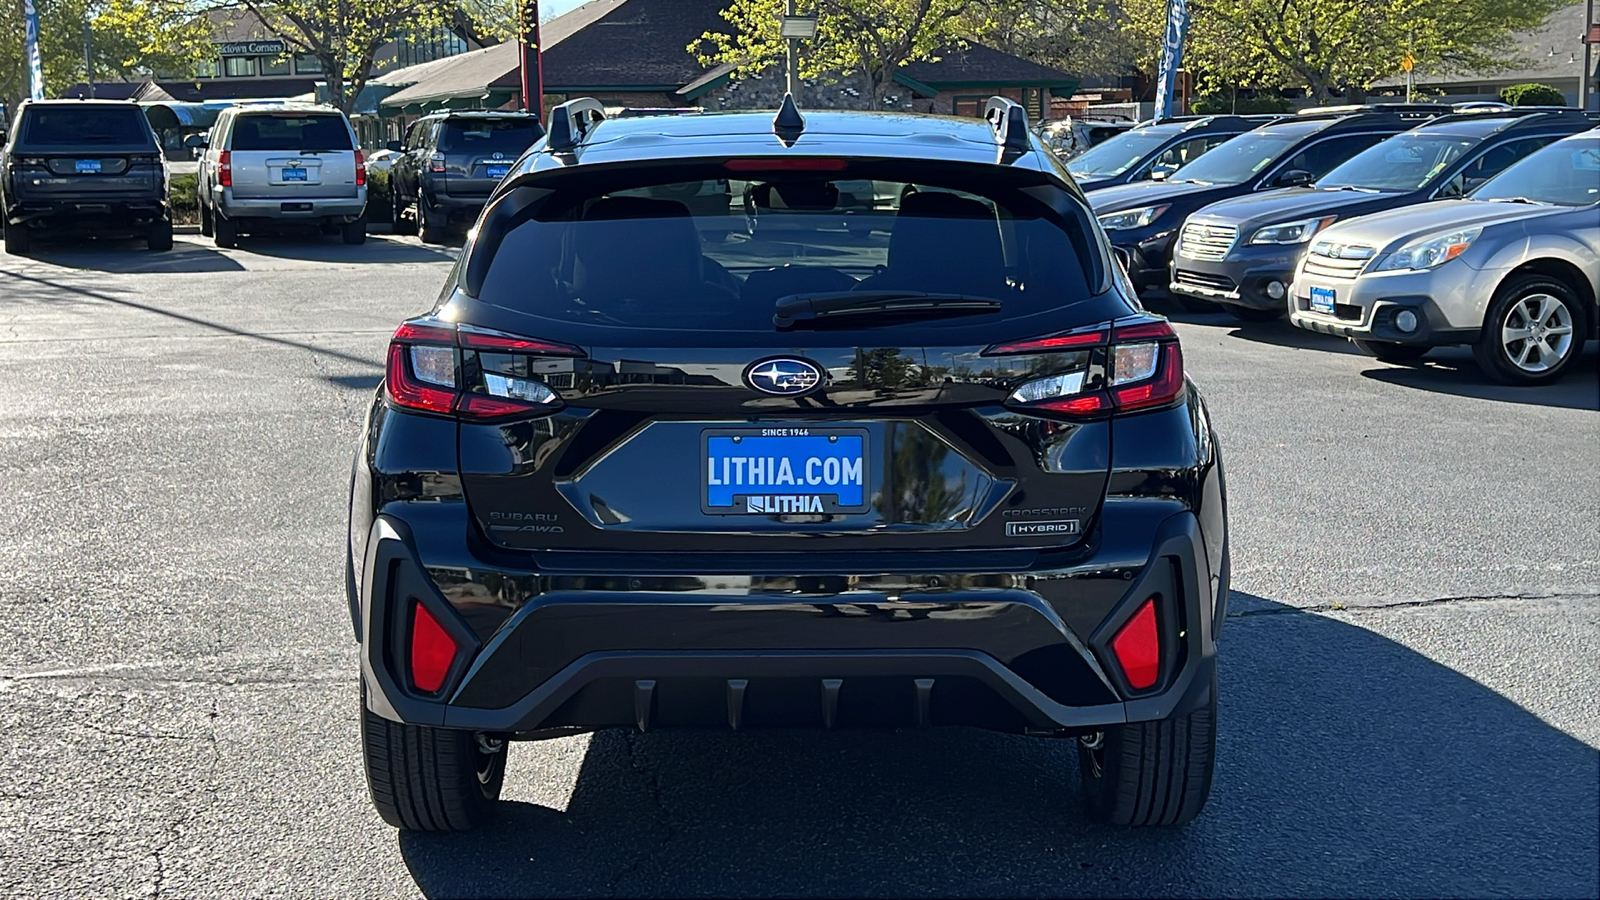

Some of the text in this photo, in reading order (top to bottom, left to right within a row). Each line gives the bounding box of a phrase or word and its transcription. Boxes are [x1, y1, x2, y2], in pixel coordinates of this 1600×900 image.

[221, 42, 282, 54] ktown Corners
[761, 428, 809, 437] SINCE 1946
[708, 457, 863, 486] LITHIA.COM
[764, 495, 824, 513] LITHIA
[490, 511, 558, 522] SUBARU
[1002, 506, 1087, 518] CROSSTREK
[519, 525, 564, 533] AWD
[1018, 524, 1068, 533] HYBRID
